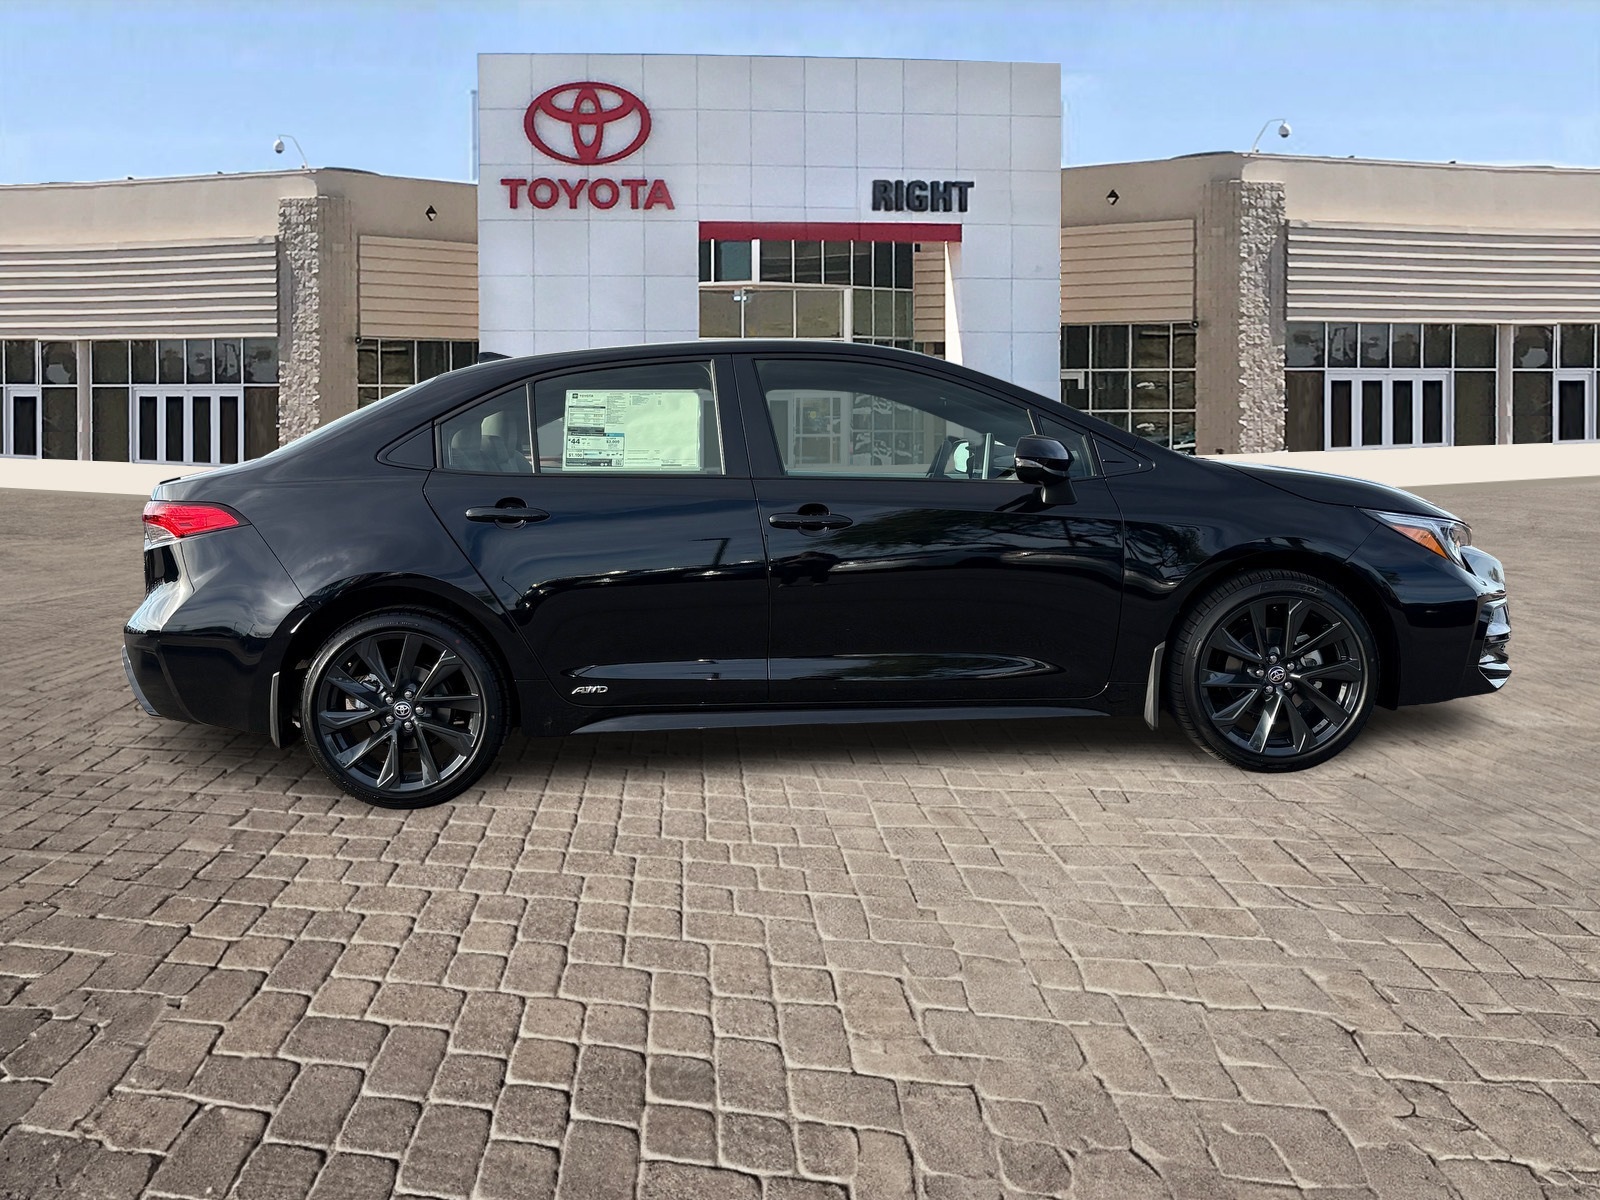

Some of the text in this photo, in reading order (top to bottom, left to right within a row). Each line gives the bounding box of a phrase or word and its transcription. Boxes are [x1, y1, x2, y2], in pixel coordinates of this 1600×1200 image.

[500, 178, 675, 209] TOYOTA
[872, 180, 974, 212] RIGHT
[571, 685, 608, 695] AWD
